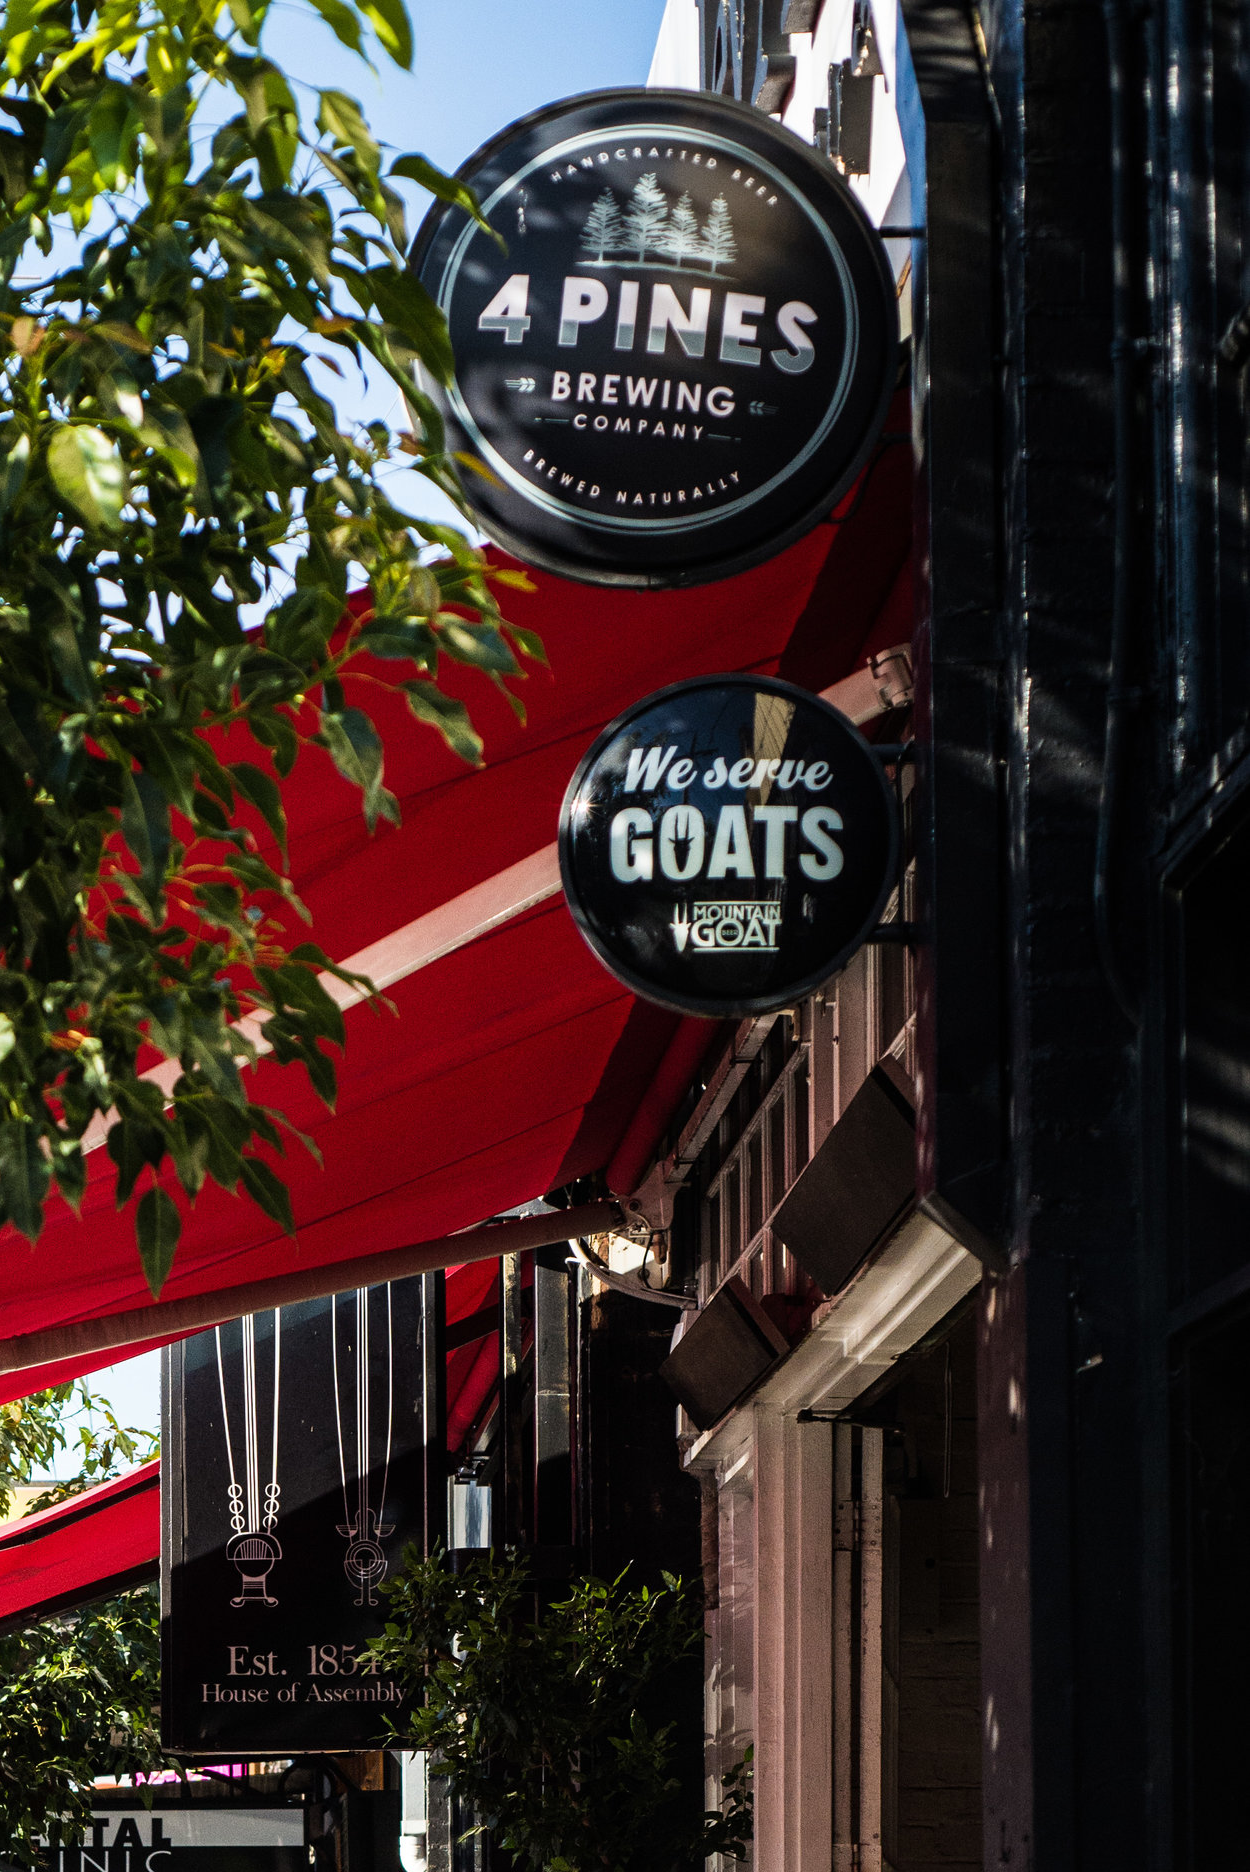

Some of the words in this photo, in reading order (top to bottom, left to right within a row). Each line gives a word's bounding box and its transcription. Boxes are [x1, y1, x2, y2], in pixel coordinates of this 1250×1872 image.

[551, 147, 717, 183] HANDCRAFTED
[731, 169, 778, 206] BEER
[478, 274, 531, 344] 4
[557, 276, 819, 375] PINES
[552, 370, 737, 418] BREWING
[573, 413, 705, 441] COMPANY
[523, 449, 601, 499] BREWED
[616, 471, 739, 505] NATURALLY
[623, 745, 697, 793] We
[703, 756, 834, 792] serve
[610, 804, 845, 884] GOATS
[691, 918, 783, 947] GOAT
[693, 905, 782, 921] MOUNTAIN
[226, 1645, 288, 1677] Est.
[202, 1683, 269, 1703] House
[277, 1682, 300, 1703] of
[307, 1681, 408, 1708] Assembly
